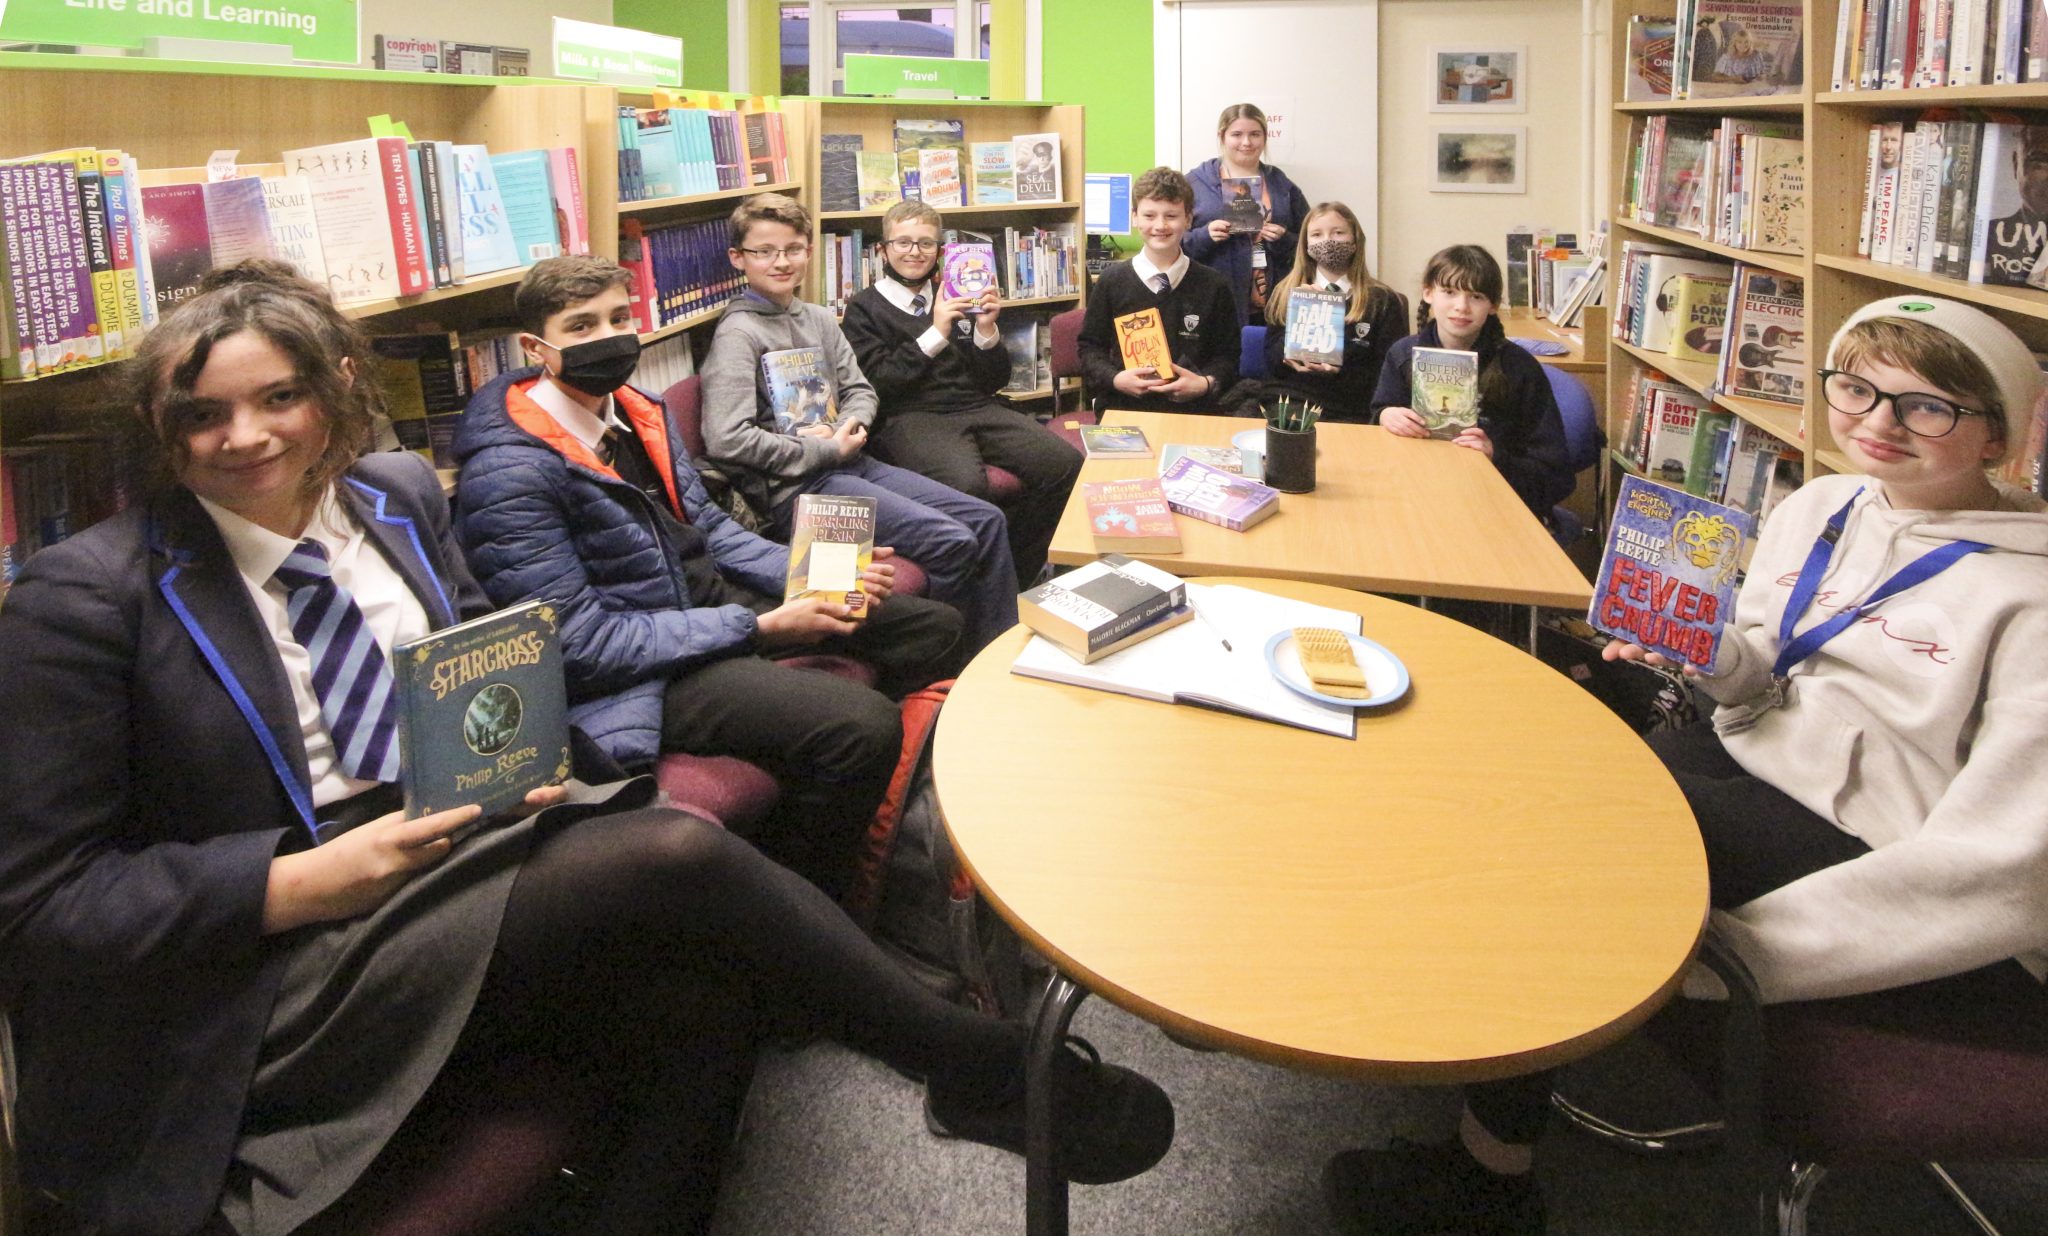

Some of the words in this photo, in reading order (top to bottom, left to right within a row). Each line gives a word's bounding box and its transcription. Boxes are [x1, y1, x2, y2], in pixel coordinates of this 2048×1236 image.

[137, 0, 193, 18] and
[203, 1, 318, 36] Learning
[1726, 14, 1758, 22] Essential
[1760, 15, 1780, 23] Skills
[1782, 16, 1793, 24] for
[1760, 7, 1793, 16] SECRETS
[1745, 22, 1793, 32] Dressmakers
[386, 39, 438, 54] copyright
[592, 56, 601, 68] &
[1653, 57, 1673, 67] ORI
[902, 69, 939, 82] Travel
[1267, 115, 1284, 123] AFF
[1267, 130, 1282, 138] NLY
[820, 142, 843, 152] LACK
[391, 153, 402, 173] TEN
[983, 156, 1006, 164] SLOW
[48, 167, 59, 175] A
[1026, 173, 1046, 184] SEA
[395, 175, 408, 205] TYPES
[1020, 183, 1053, 193] DEVIL
[1882, 175, 1894, 197] TIM
[1924, 164, 1938, 202] Katie
[41, 192, 52, 211] FOR
[50, 177, 65, 222] PARENT'S
[68, 196, 77, 207] IN
[84, 183, 98, 206] The
[110, 184, 123, 210] iPod
[268, 195, 306, 209] RSCALE
[3, 196, 15, 215] FOR
[19, 209, 30, 228] FOR
[30, 207, 41, 226] FOR
[69, 208, 81, 236] EASY
[113, 214, 126, 223] &
[1878, 201, 1891, 243] PEAKE
[1920, 205, 1936, 243] Price
[6, 218, 21, 263] SENIORS
[44, 214, 59, 256] SENIORS
[57, 223, 70, 256] GUIDE
[88, 209, 108, 265] Internet
[115, 226, 129, 262] iTunes
[401, 212, 416, 255] HUMAN
[22, 230, 36, 274] SENIORS
[32, 228, 48, 272] SENIORS
[73, 238, 87, 268] STEPS
[12, 266, 22, 276] IN
[50, 258, 61, 269] IN
[62, 257, 73, 269] TO
[27, 277, 38, 287] IN
[38, 274, 49, 284] IN
[52, 271, 64, 300] EASY
[64, 271, 76, 290] THE
[14, 278, 26, 308] EASY
[30, 290, 42, 317] EASY
[41, 286, 53, 314] EASY
[1292, 291, 1317, 299] PHILIP
[1317, 294, 1343, 303] REEVE
[1747, 294, 1778, 304] LEARN
[100, 282, 120, 333] DUMMIE
[122, 280, 140, 328] DUMMIE
[1745, 301, 1804, 318] ELECTRIC
[17, 309, 30, 338] STEPS
[55, 301, 70, 329] STEPS
[33, 319, 47, 350] STEPS
[45, 316, 59, 343] STEPS
[1290, 322, 1337, 354] HEAD
[777, 352, 815, 366] PHILIP
[1417, 361, 1472, 378] UTTERLY
[1426, 373, 1465, 387] DARK
[1666, 396, 1678, 404] THE
[1630, 489, 1672, 510] MORTAL
[806, 503, 838, 516] PHILIP
[839, 505, 870, 518] REEVE
[1627, 500, 1673, 521] ENGINES
[1616, 525, 1666, 552] PHILIP
[1615, 540, 1661, 567] REEVE
[1608, 556, 1719, 625] FEVER
[1114, 614, 1142, 634] BLACKMAN
[1601, 594, 1715, 665] CRUMB
[429, 630, 545, 701] STARCROSS
[455, 767, 493, 792] Philip
[496, 746, 539, 774] Reeve
